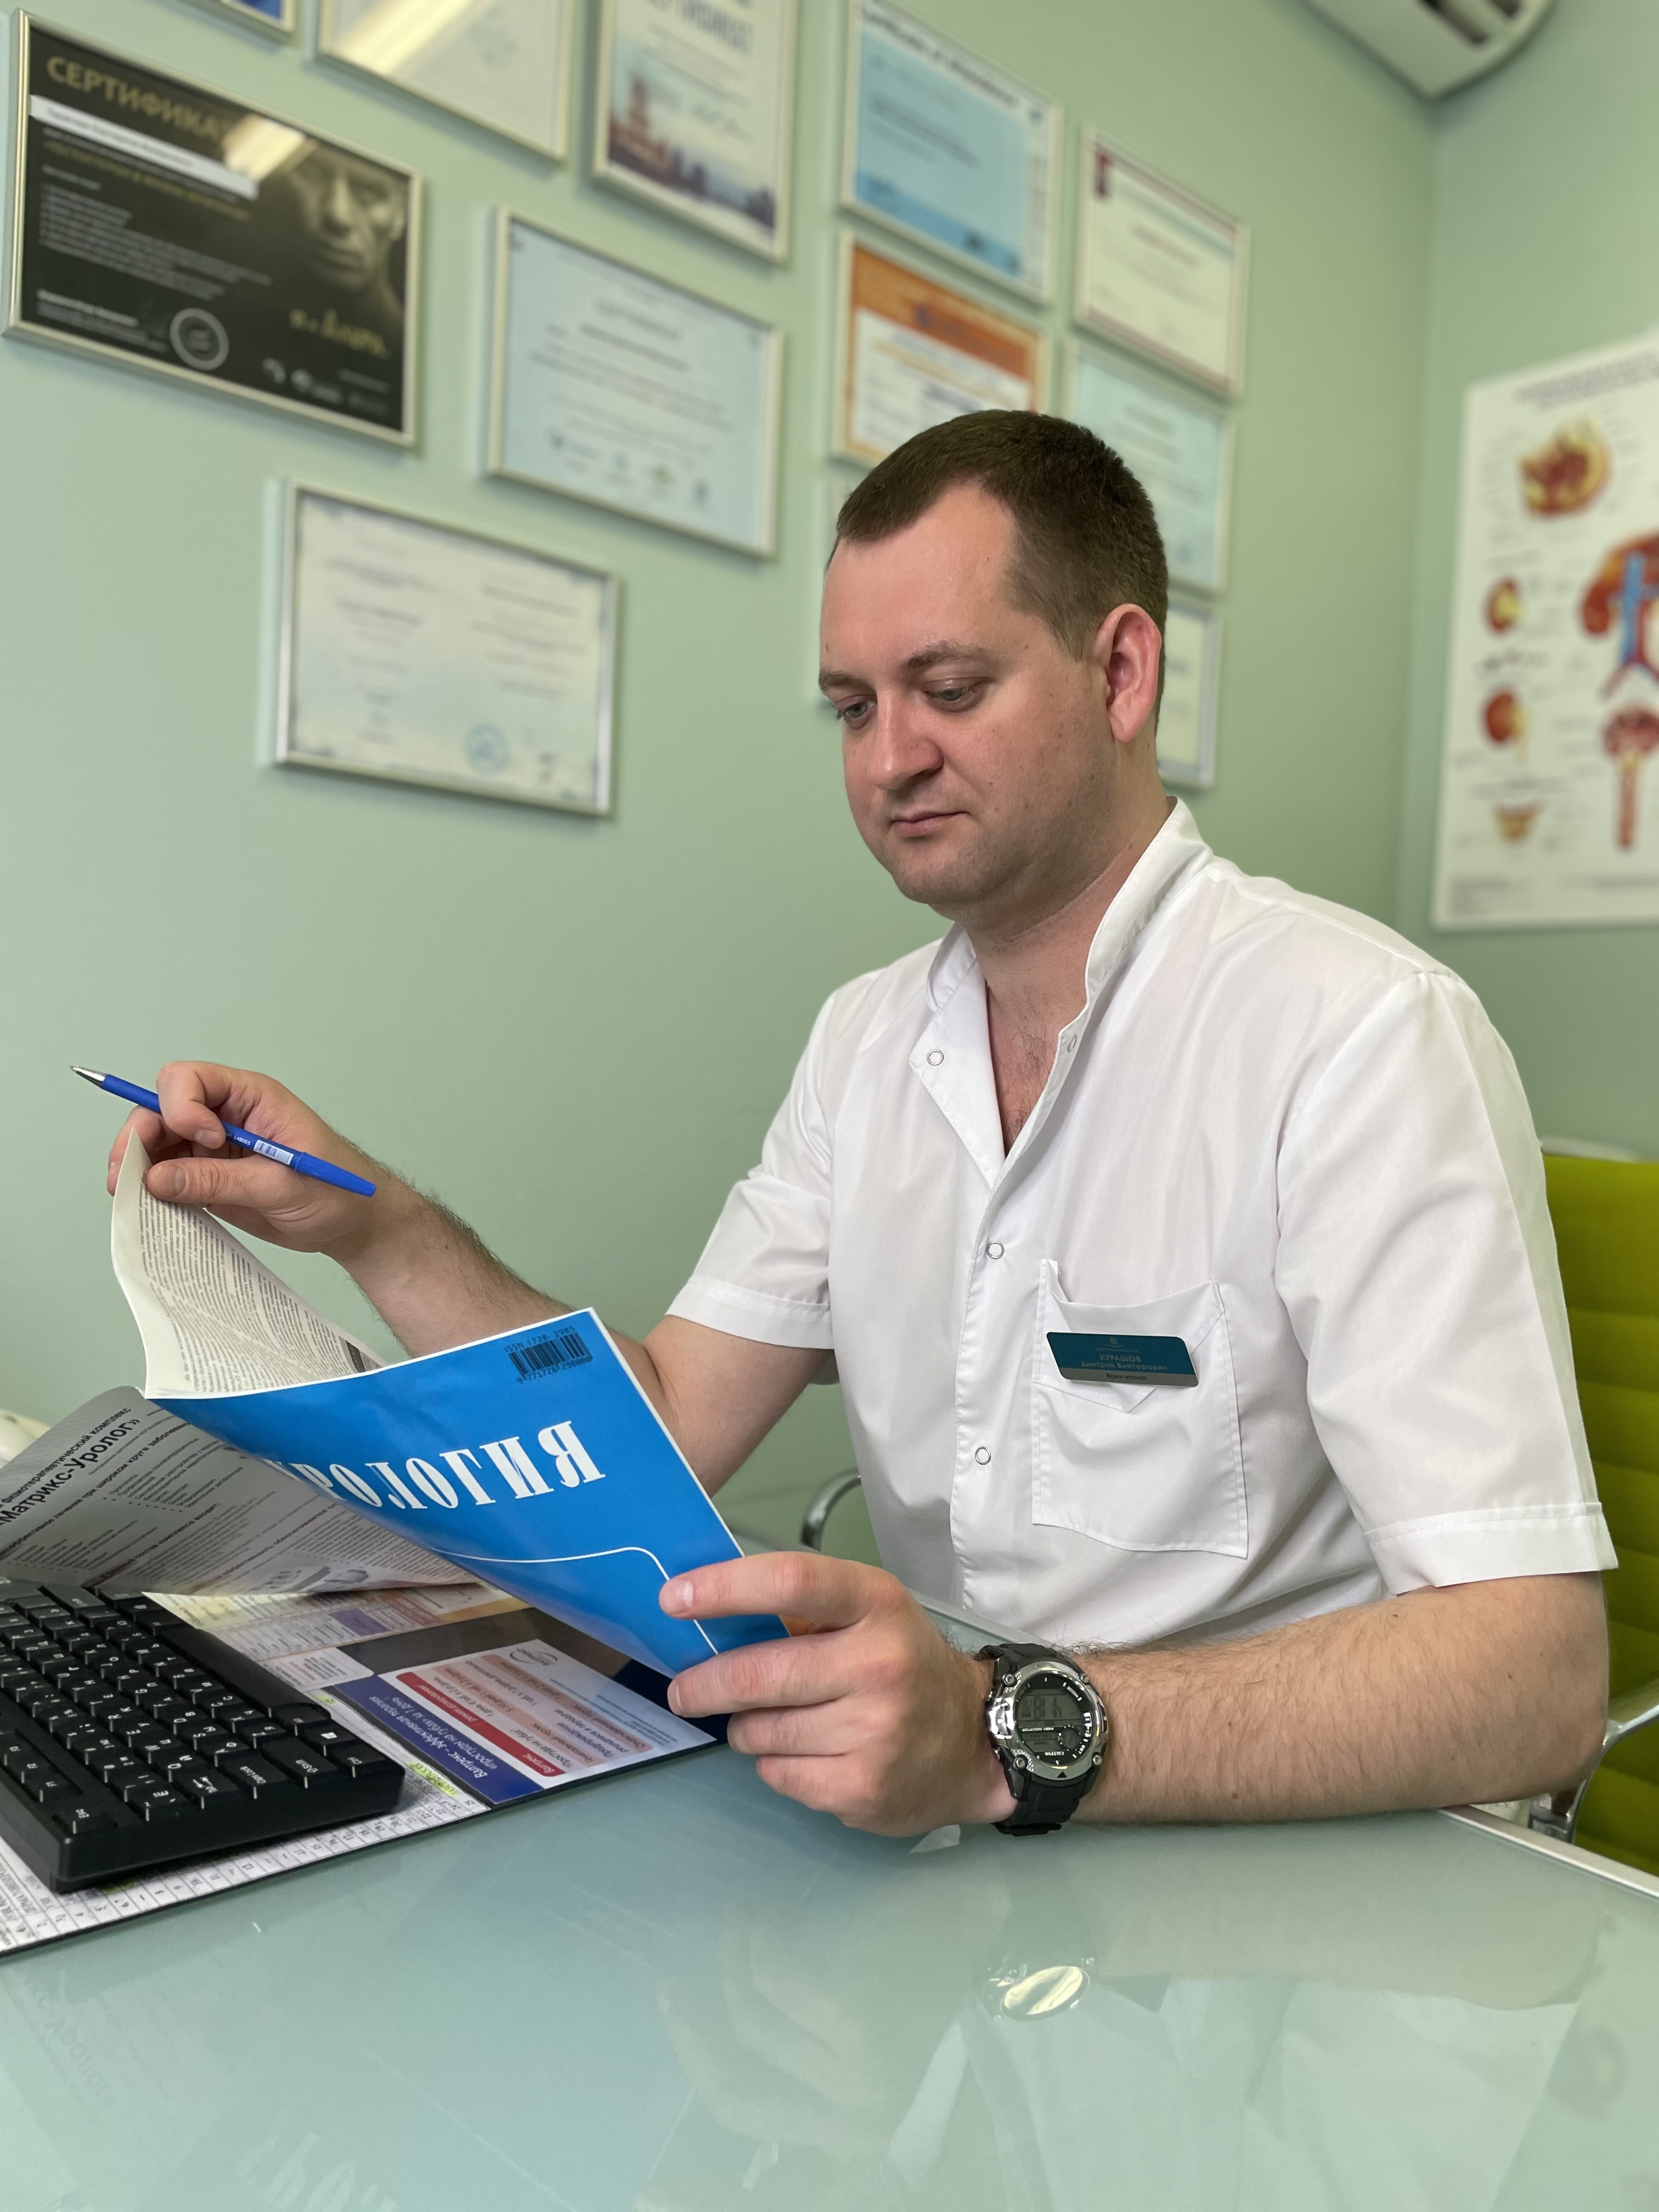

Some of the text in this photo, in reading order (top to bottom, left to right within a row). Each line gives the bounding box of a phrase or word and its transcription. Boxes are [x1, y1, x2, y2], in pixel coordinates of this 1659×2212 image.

[504, 1342, 524, 1353] ISSN
[1081, 1361, 1167, 1371] Дмитрий Викторович
[1099, 1354, 1141, 1362] КУРАШОВ
[90, 1408, 132, 1435] комплекс
[95, 1464, 129, 1488] широком
[127, 1447, 150, 1464] круге
[276, 1421, 606, 1509] РОЛОГИЯ
[368, 1695, 488, 1778] Валтрекс эффективная терапия
[347, 1757, 363, 1765] Ctrl
[453, 1740, 497, 1769] «простуды
[76, 1809, 90, 1819] Esc
